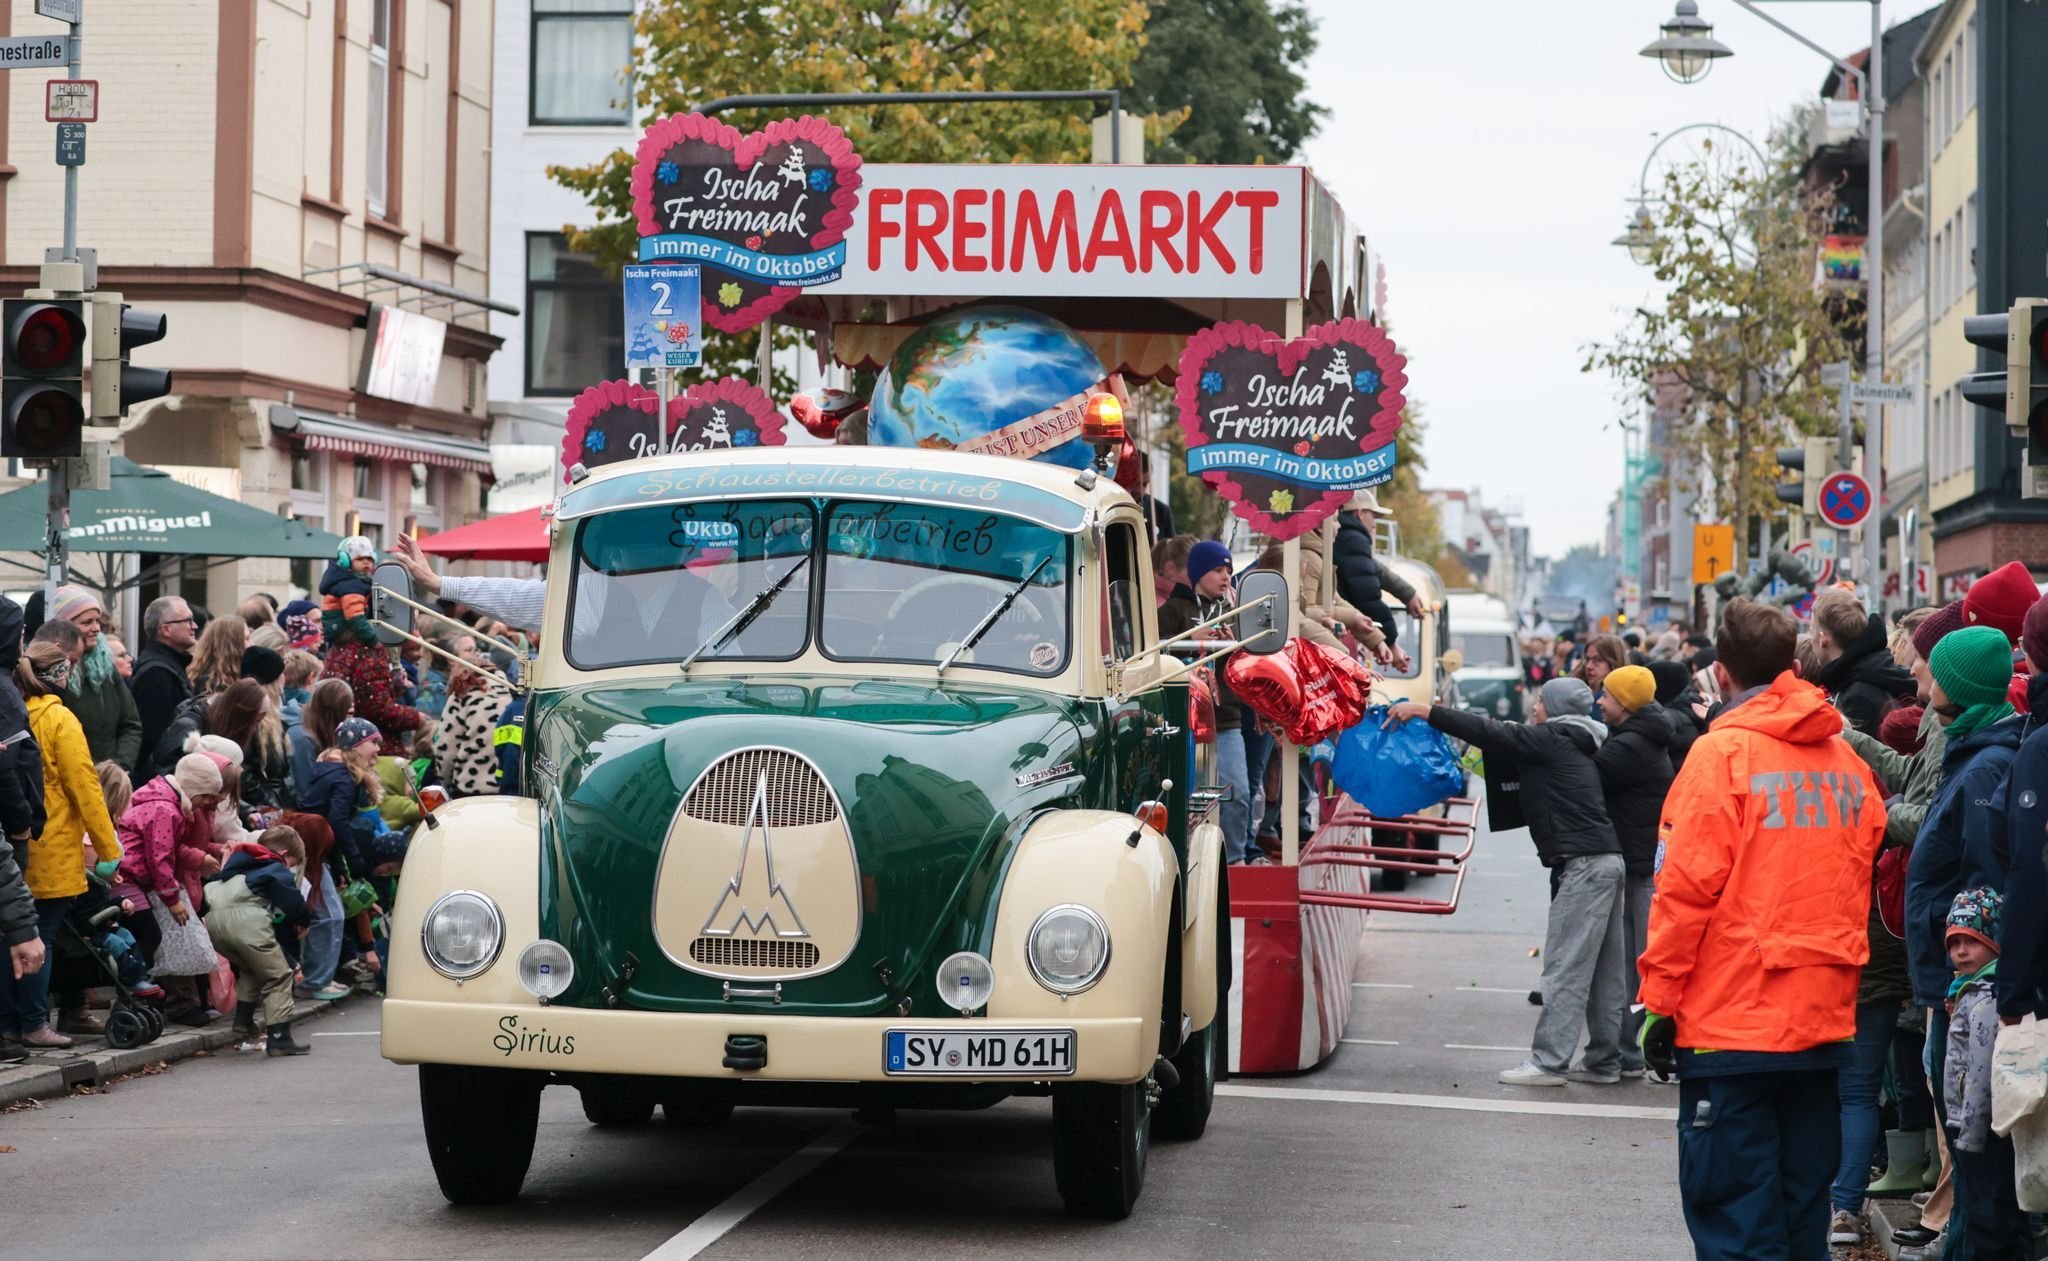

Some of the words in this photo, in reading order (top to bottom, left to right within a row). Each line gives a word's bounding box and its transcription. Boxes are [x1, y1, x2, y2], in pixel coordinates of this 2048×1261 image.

[702, 161, 781, 202] Ischa
[663, 193, 809, 238] Freimaak
[867, 188, 1279, 275] FREIMARKT
[626, 269, 650, 278] Ischa
[651, 267, 699, 278] Freimaak!
[653, 238, 722, 259] immer
[725, 246, 750, 270] im
[756, 250, 837, 277] Oktober
[778, 271, 840, 288] www.freimarkt.de
[650, 281, 674, 316] 2
[1247, 366, 1325, 408] Ischa
[1020, 408, 1081, 448] UNSER
[1209, 396, 1357, 441] Freimaak
[638, 466, 1002, 500] Schaustellerbetrieb
[1202, 448, 1270, 466] immer
[1274, 453, 1299, 476] im
[1306, 452, 1388, 481] Oktober
[1330, 473, 1392, 492] www.freimarkt.de
[43, 511, 212, 541] anMiguel
[685, 521, 738, 537] Okto
[1750, 771, 1865, 829] THW
[493, 1015, 575, 1056] Sirius
[907, 1038, 945, 1066] SY
[967, 1038, 1006, 1066] MD
[1014, 1038, 1069, 1066] 61H
